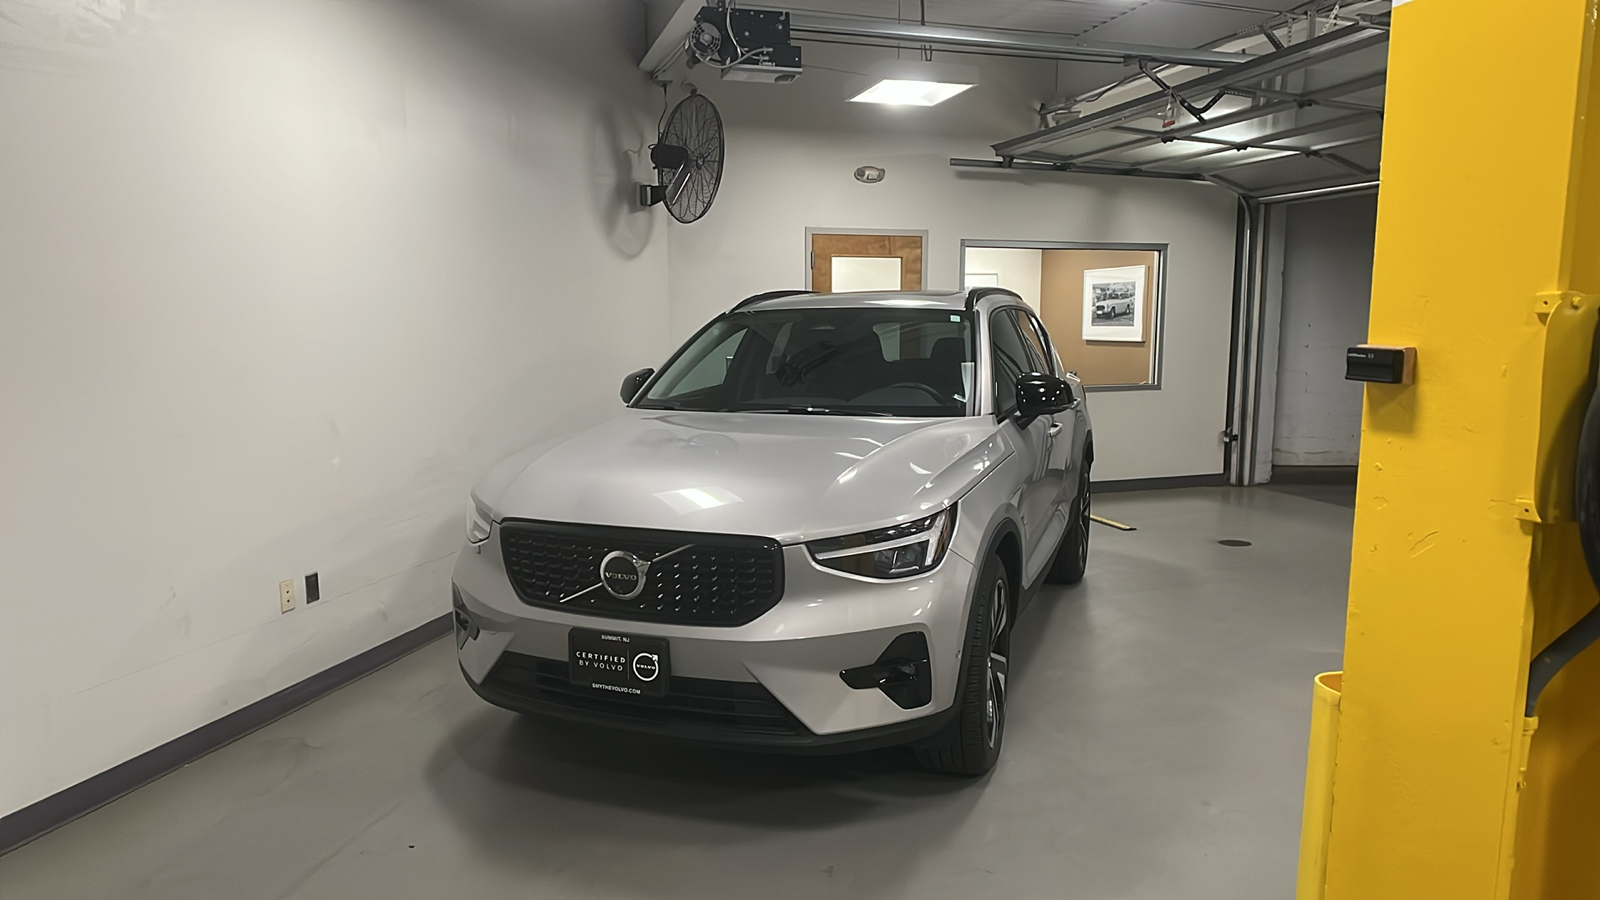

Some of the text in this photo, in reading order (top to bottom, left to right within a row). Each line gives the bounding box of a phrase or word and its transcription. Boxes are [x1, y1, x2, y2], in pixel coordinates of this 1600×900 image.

[605, 572, 637, 581] VOLVO
[576, 651, 626, 664] CERTIFIED
[579, 659, 623, 671] BY VOLVO
